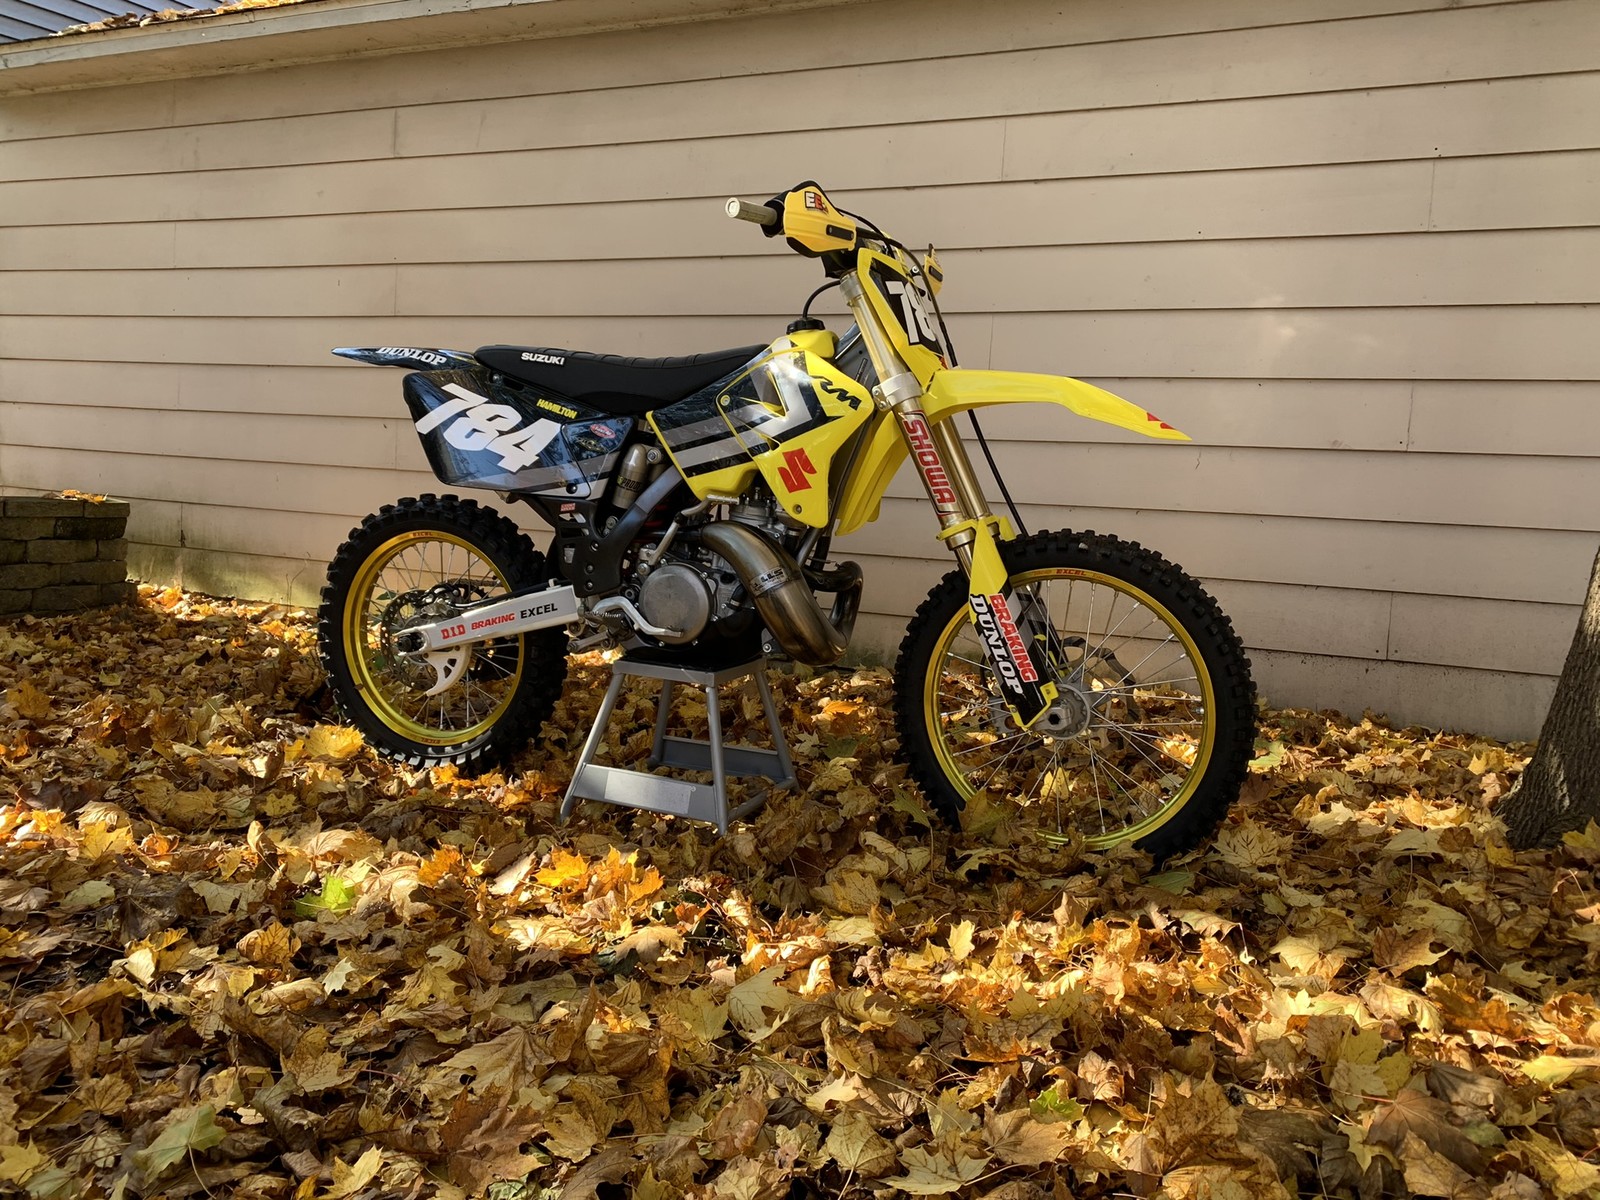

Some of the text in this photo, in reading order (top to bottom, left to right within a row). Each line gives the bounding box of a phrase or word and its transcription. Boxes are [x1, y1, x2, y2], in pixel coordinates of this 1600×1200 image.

[375, 347, 448, 365] DUNLOP
[521, 352, 565, 365] SUZUKI
[414, 382, 562, 474] 784
[536, 399, 578, 419] HAMILTON
[903, 418, 957, 506] SHOWA
[471, 613, 515, 630] BRAKING
[520, 603, 558, 619] EXCEL
[969, 593, 1025, 695] DUNLOP
[988, 593, 1039, 683] BRAKING
